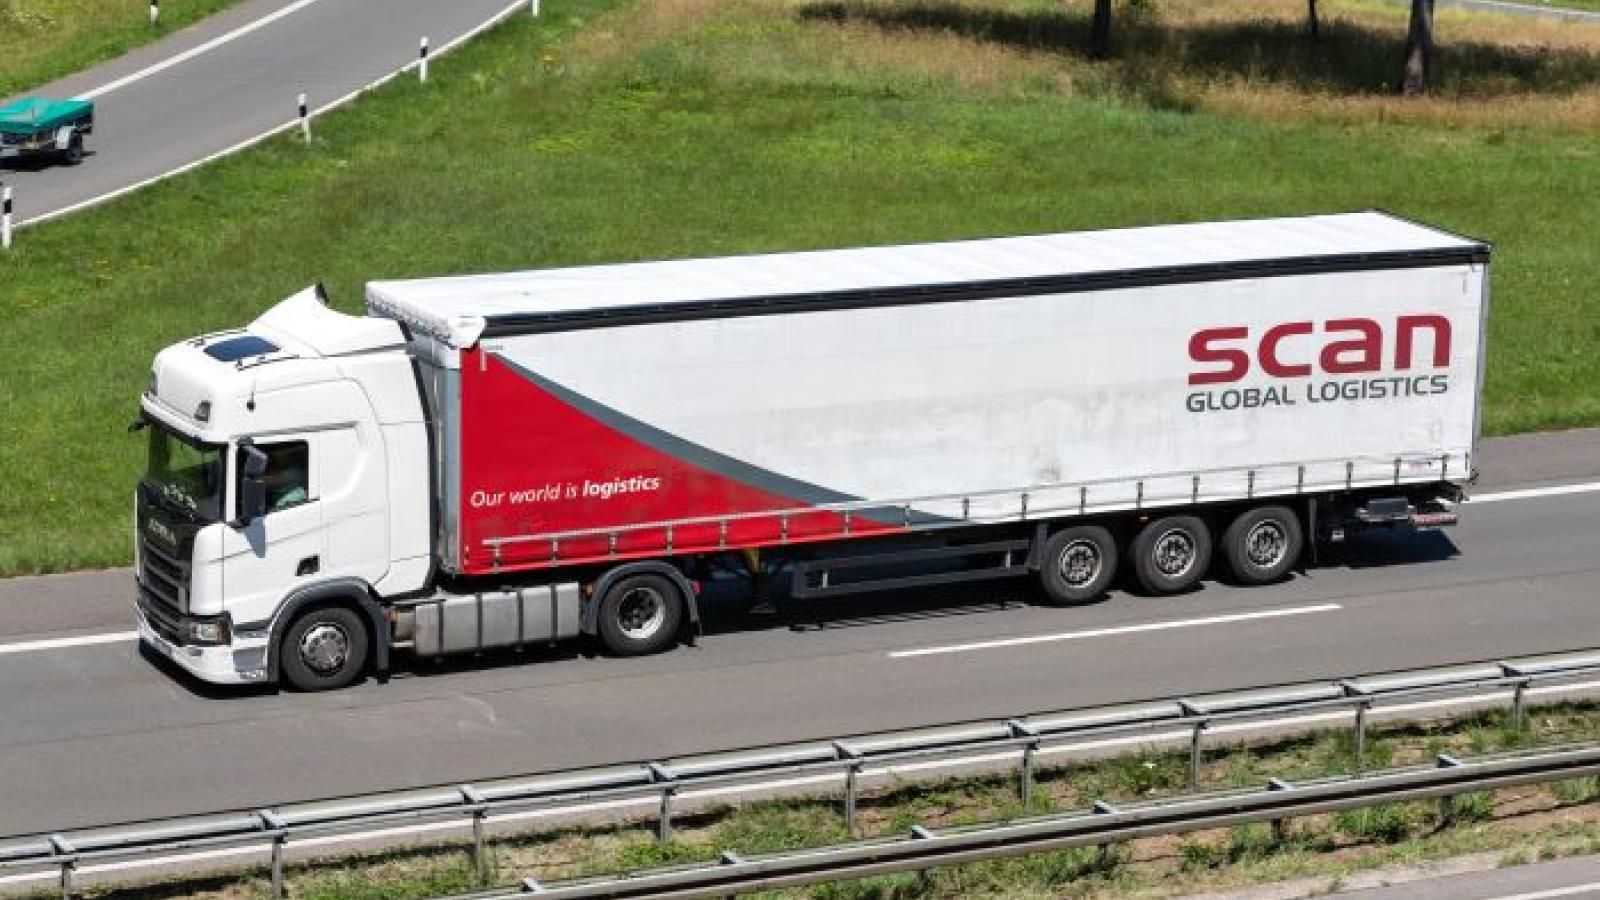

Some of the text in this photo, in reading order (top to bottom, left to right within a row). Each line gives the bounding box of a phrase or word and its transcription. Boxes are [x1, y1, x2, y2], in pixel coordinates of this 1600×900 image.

[1188, 314, 1451, 385] scan
[1186, 375, 1448, 413] GLOBAL LOGISTICS
[470, 476, 661, 507] Our world is logistics
